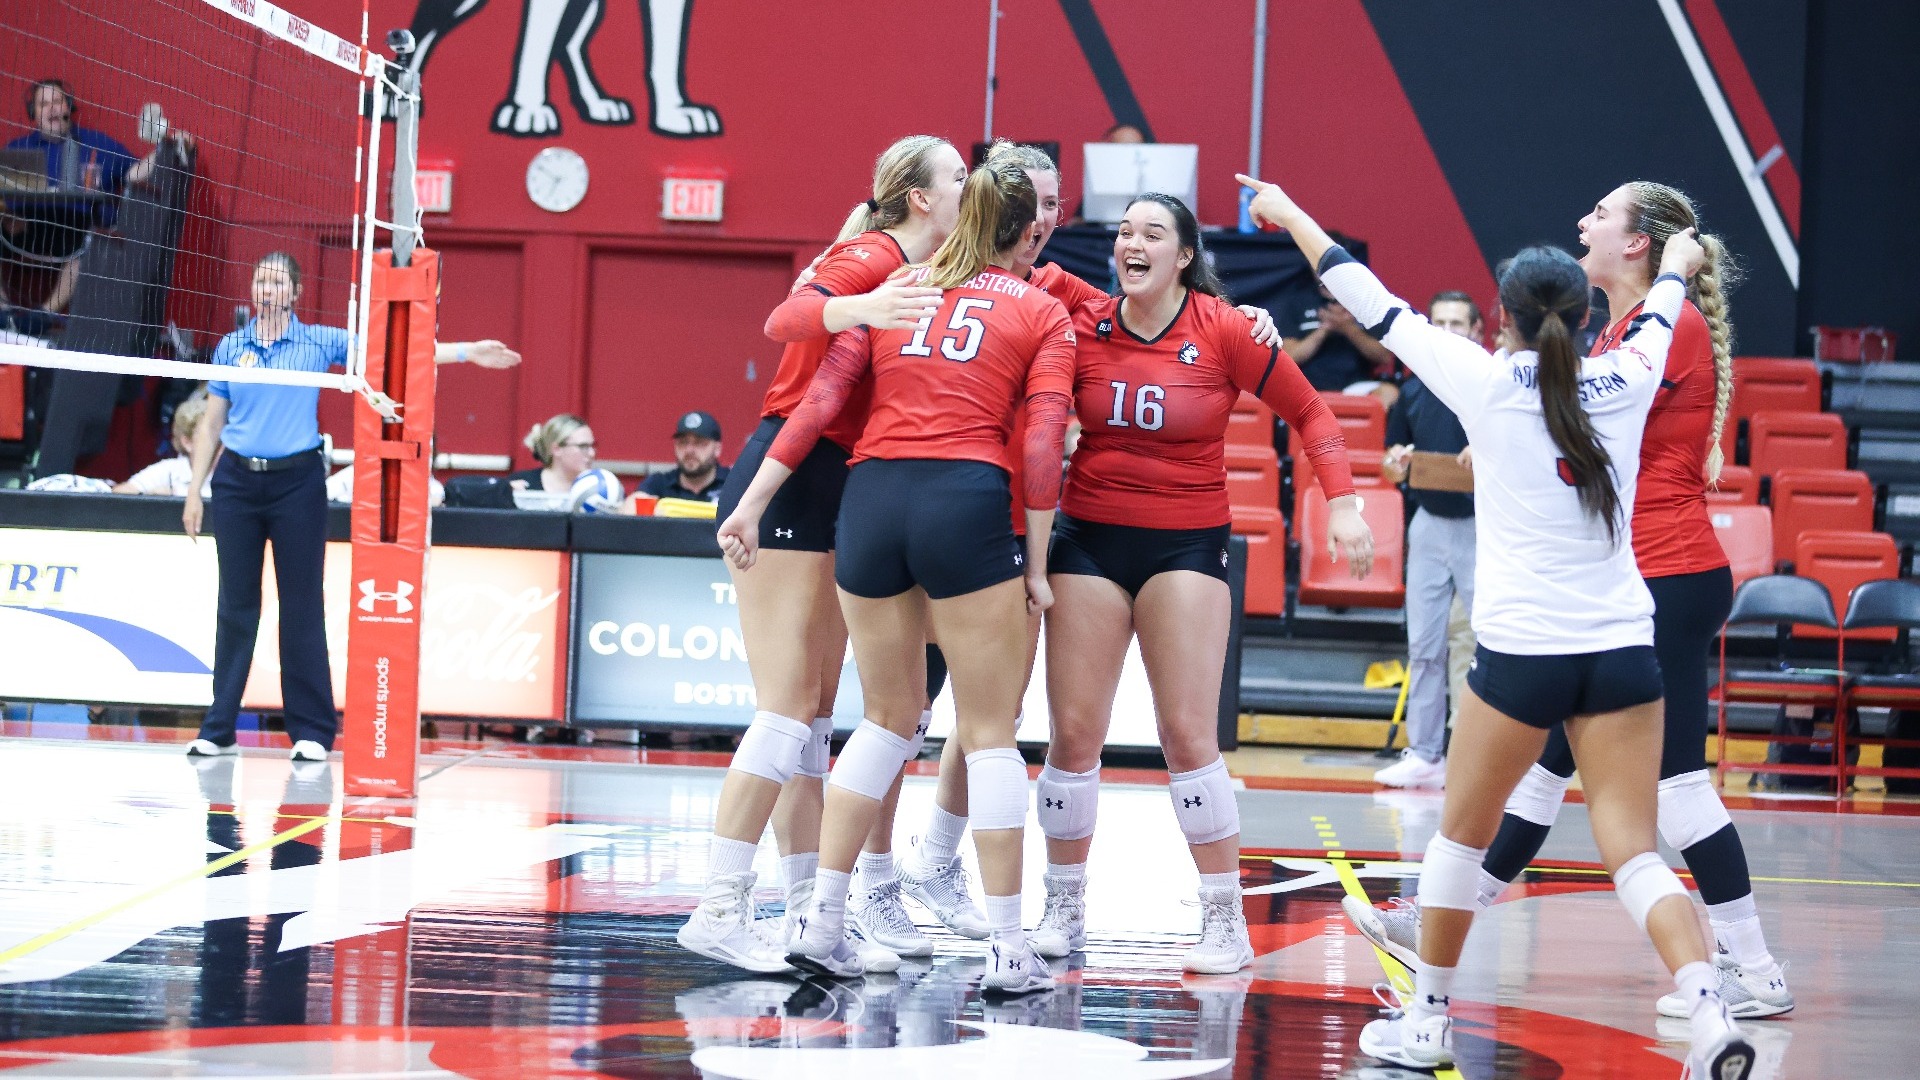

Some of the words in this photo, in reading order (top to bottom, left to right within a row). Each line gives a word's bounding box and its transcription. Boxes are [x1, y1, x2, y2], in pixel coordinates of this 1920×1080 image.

[414, 175, 444, 208] XIT
[671, 183, 715, 216] EXIT
[899, 295, 995, 363] 15
[1106, 380, 1166, 431] 16
[0, 562, 79, 594] RT
[588, 620, 749, 662] COLON
[375, 656, 390, 702] sports
[673, 681, 758, 706] BOST
[372, 703, 388, 759] imports
